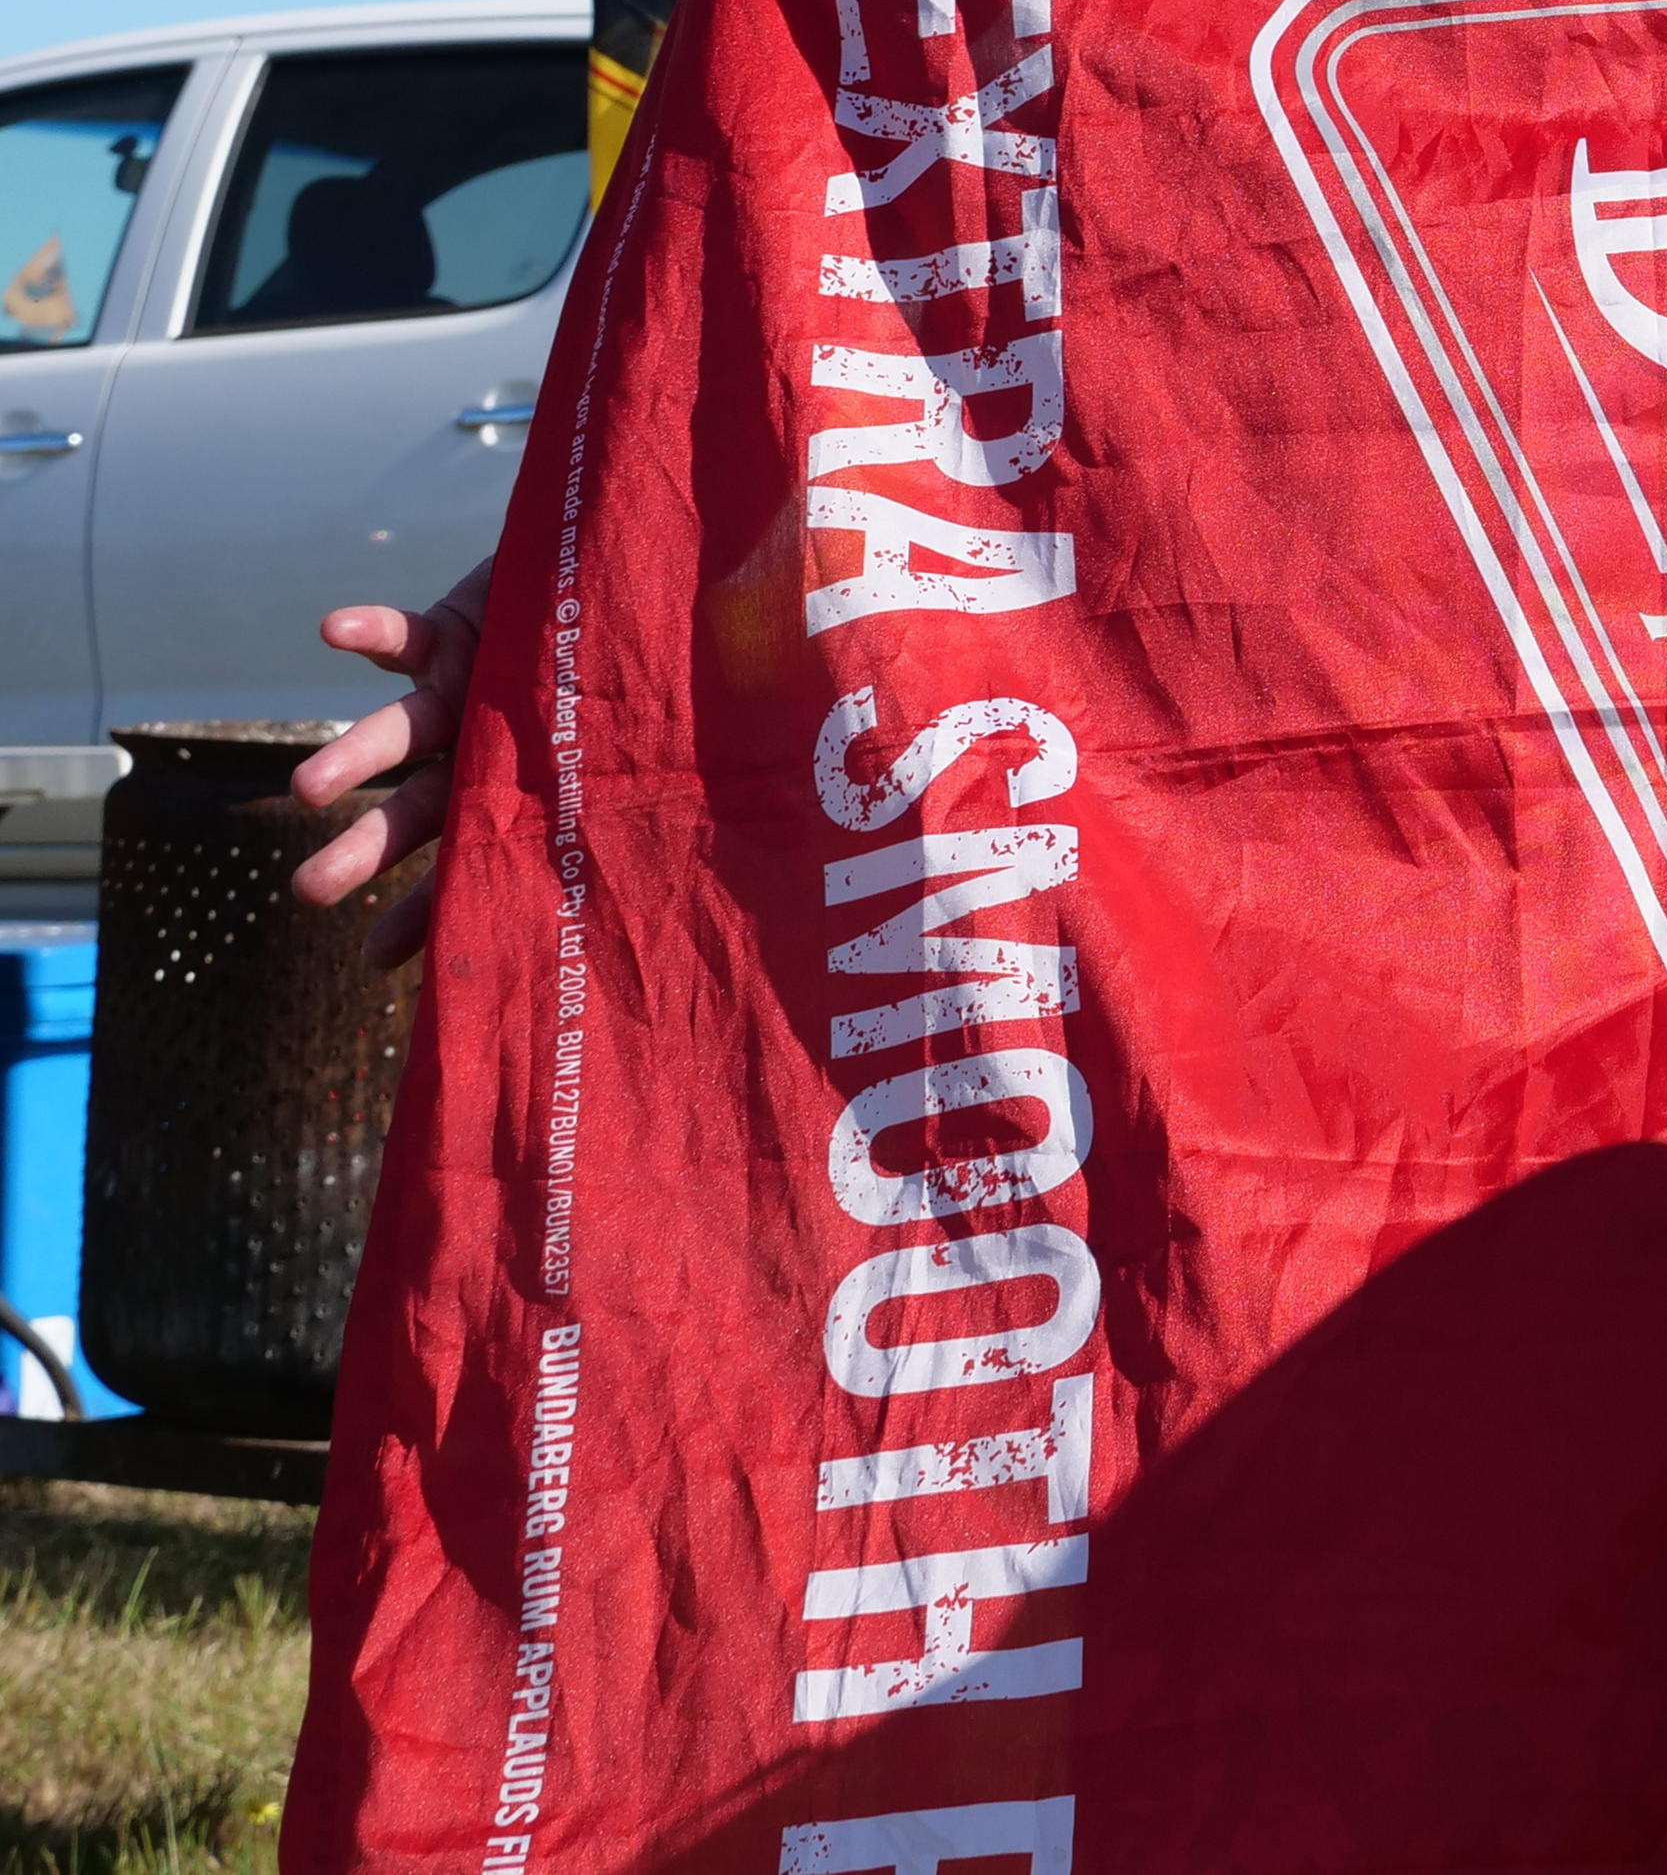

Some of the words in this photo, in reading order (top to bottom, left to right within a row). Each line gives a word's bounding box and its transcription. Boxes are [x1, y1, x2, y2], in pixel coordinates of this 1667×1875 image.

[570, 433, 586, 465] are
[563, 466, 584, 520] trade
[556, 525, 580, 593] marks.
[552, 627, 581, 744] Bundaberg
[556, 748, 583, 845] Distilling
[561, 849, 584, 879] Co
[557, 883, 586, 917] Pty
[560, 923, 586, 958] Ltd
[559, 963, 586, 1025] 2008.
[792, 685, 1101, 1724] SMOOTH
[525, 1323, 581, 1538] BUNDABERG
[520, 1546, 562, 1631] RUM
[494, 1642, 554, 1827] APPLAUDS
